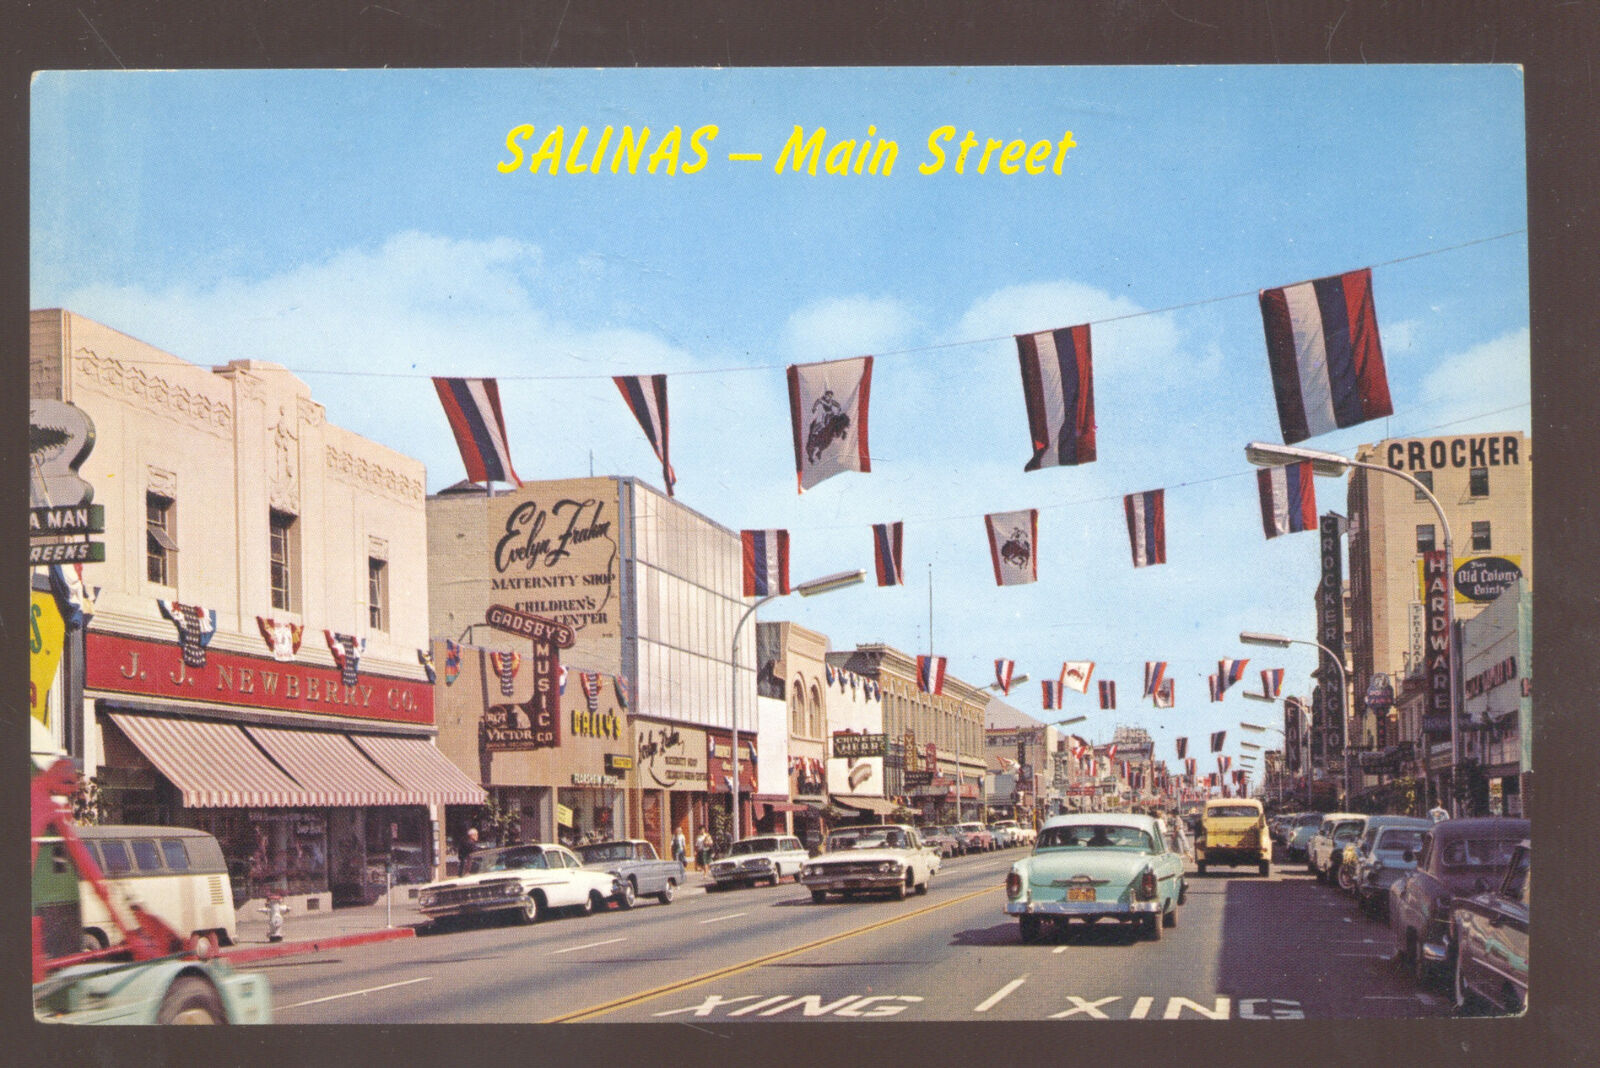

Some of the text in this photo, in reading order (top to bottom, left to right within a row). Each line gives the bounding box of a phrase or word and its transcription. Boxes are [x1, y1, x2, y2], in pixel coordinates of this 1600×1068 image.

[1387, 436, 1519, 470] CROCKER
[48, 509, 88, 528] MAN
[495, 501, 551, 573] Evelyn
[492, 574, 616, 590] MATERNITY SHOP
[1323, 519, 1336, 639] CROCKER
[1458, 569, 1519, 585] Old Colony
[515, 596, 596, 613] CHILDREN'S
[554, 612, 608, 625] CENTER
[491, 610, 569, 643] GADSBY'S
[1430, 559, 1449, 709] HARDWARE
[120, 652, 418, 713] J. J. NEWBERRY CO.
[536, 644, 550, 726] MUSIC
[1327, 664, 1339, 746] ANGLO
[486, 729, 534, 741] VICTOR
[652, 995, 924, 1017] XING
[1048, 996, 1304, 1019] XING
